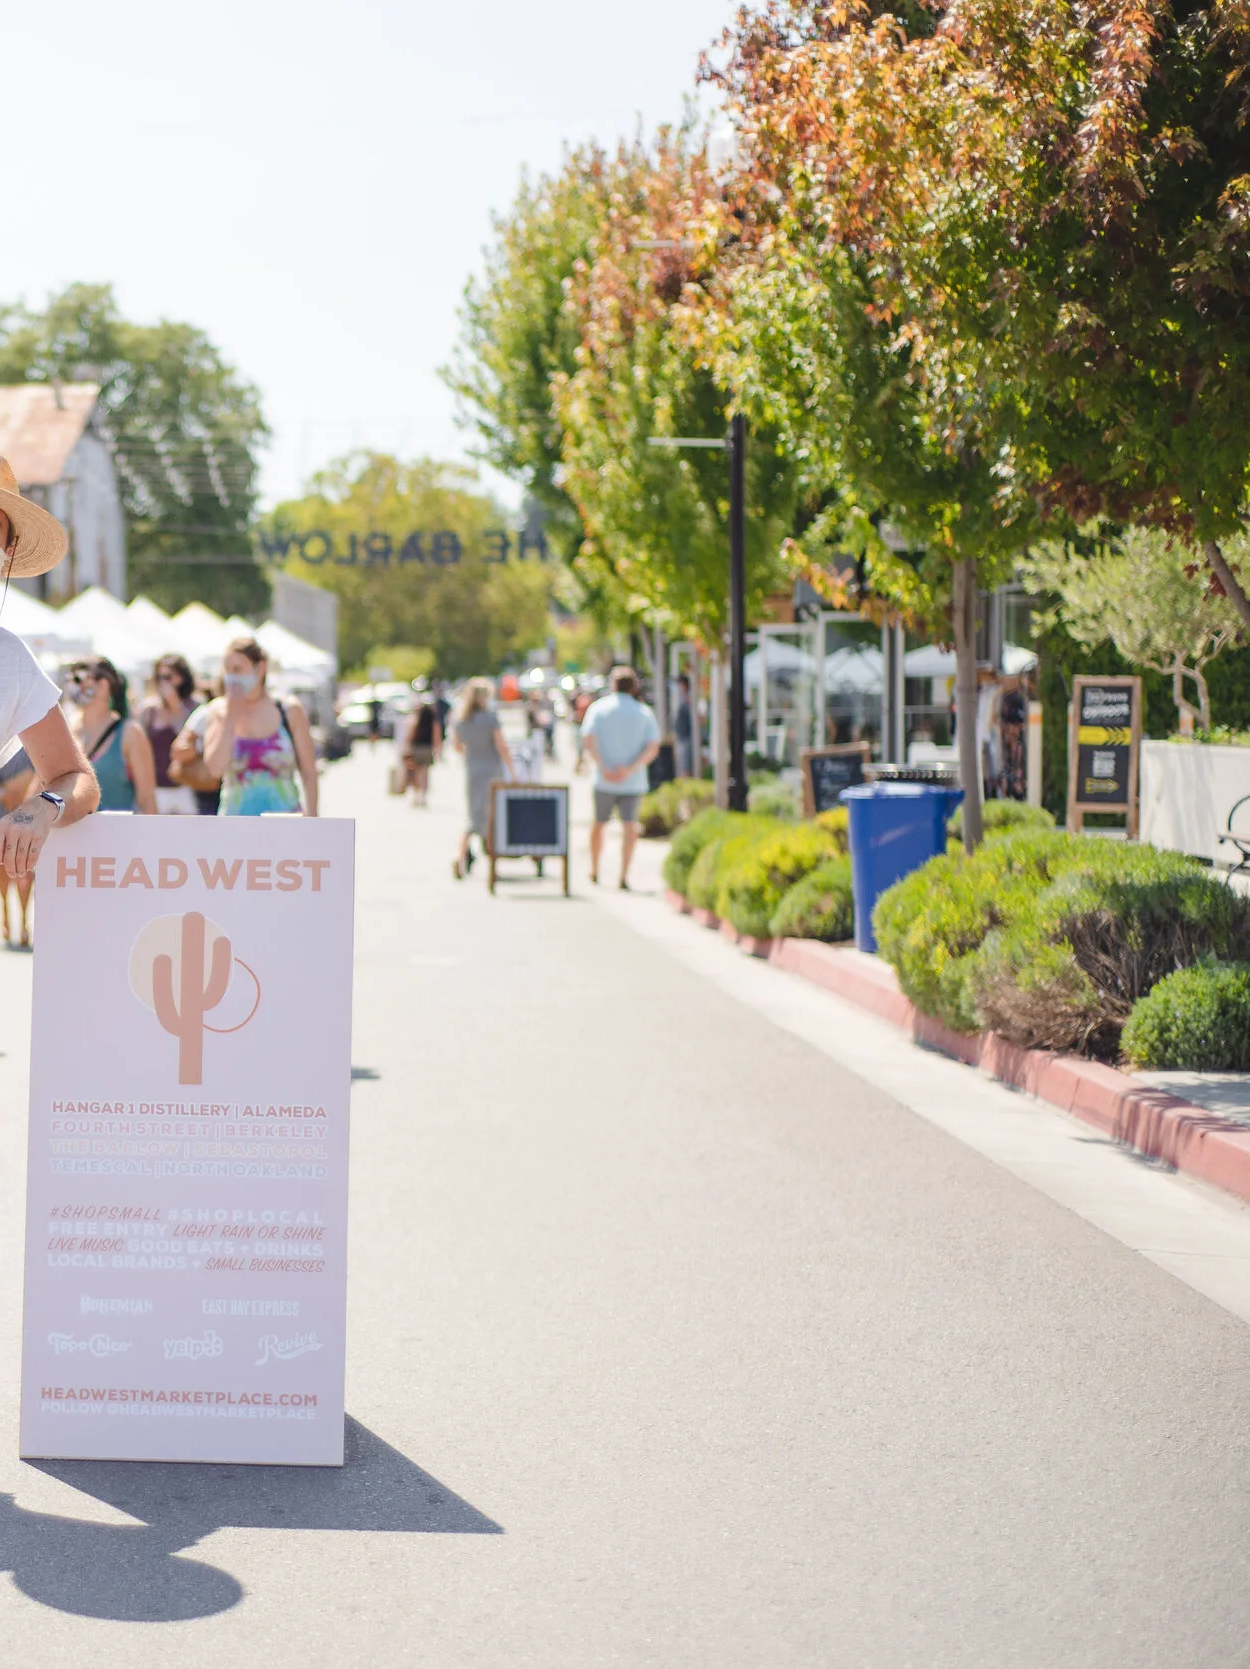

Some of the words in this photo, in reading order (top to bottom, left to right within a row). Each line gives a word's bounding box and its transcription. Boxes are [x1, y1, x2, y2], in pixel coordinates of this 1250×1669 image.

[56, 856, 188, 889] HEAD
[196, 858, 331, 892] WEST
[52, 1101, 125, 1114] HANGAR
[139, 1103, 231, 1117] DISTILLERY
[242, 1105, 327, 1119] ALAMEDA
[52, 1120, 130, 1134] FOURTH
[137, 1121, 211, 1136] STREET
[225, 1124, 327, 1139] BERKELEY
[51, 1158, 150, 1174] TEMESCAL
[163, 1162, 228, 1176] NORTH
[233, 1163, 327, 1178] OAKLAND
[50, 1205, 161, 1220] #SHOPSMALL
[167, 1208, 324, 1225] #SHOPLOCAL
[173, 1223, 216, 1238] LIGHT
[220, 1224, 253, 1239] RAIN
[257, 1225, 279, 1240] OR
[283, 1226, 327, 1241] SHINE
[48, 1237, 76, 1250] LIVE
[79, 1237, 124, 1251] MUSIC
[254, 1242, 324, 1258] DRINKS
[49, 1253, 104, 1268] LOCAL
[112, 1254, 187, 1270] BRANDS
[205, 1257, 245, 1272] SMALL
[249, 1258, 326, 1273] BUSINESSES
[41, 1387, 318, 1407] HEADWESTMARKETPLACE.COM
[41, 1401, 105, 1416] FOLLOW
